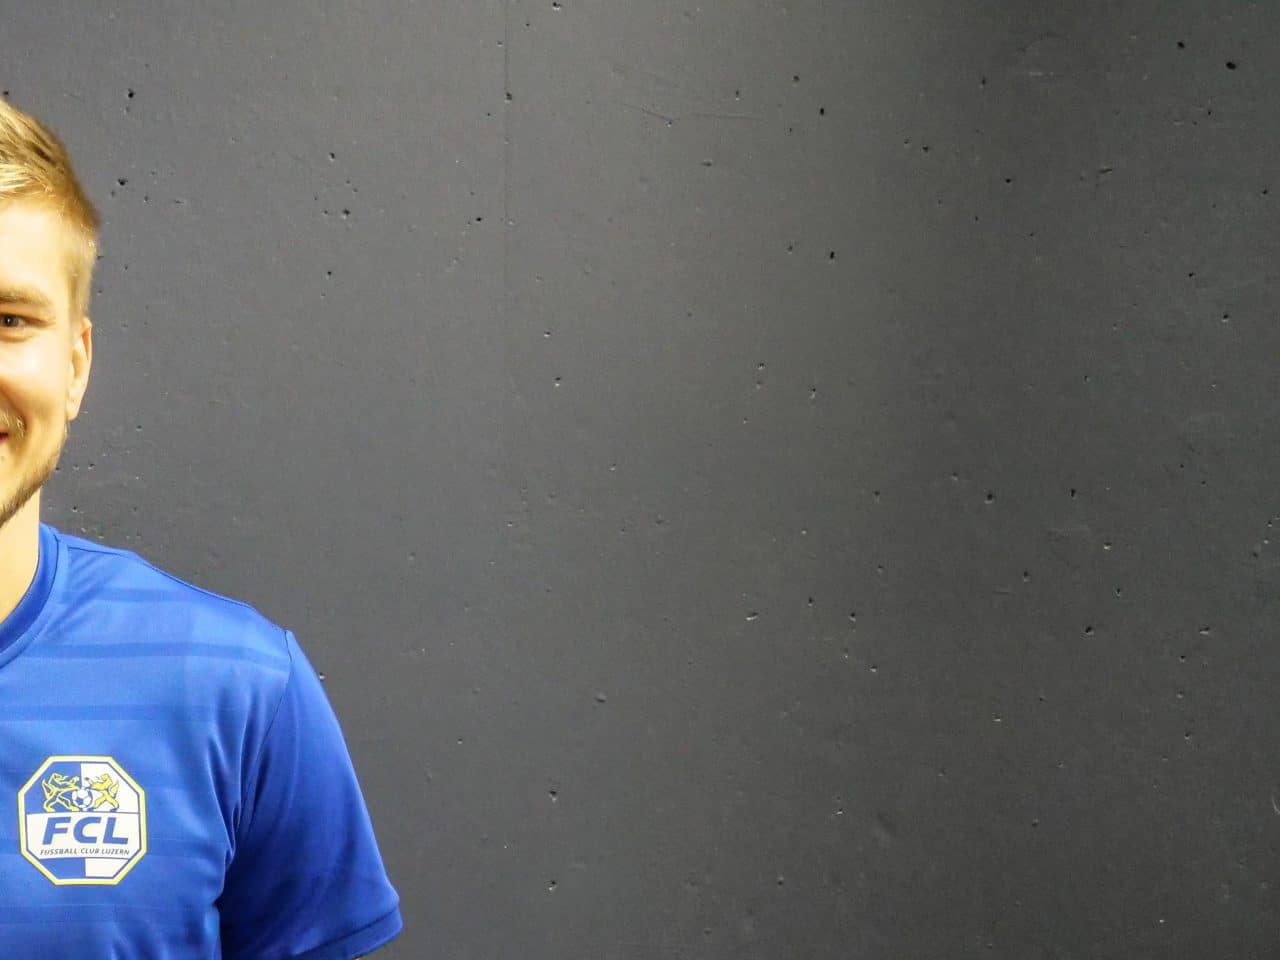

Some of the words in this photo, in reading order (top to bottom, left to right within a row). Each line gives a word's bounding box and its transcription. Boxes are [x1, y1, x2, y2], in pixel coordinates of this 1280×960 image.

[42, 816, 129, 845] FCL
[40, 848, 78, 856] FUSSBALL
[80, 847, 100, 855] CLUB
[101, 848, 130, 856] LUZERN
